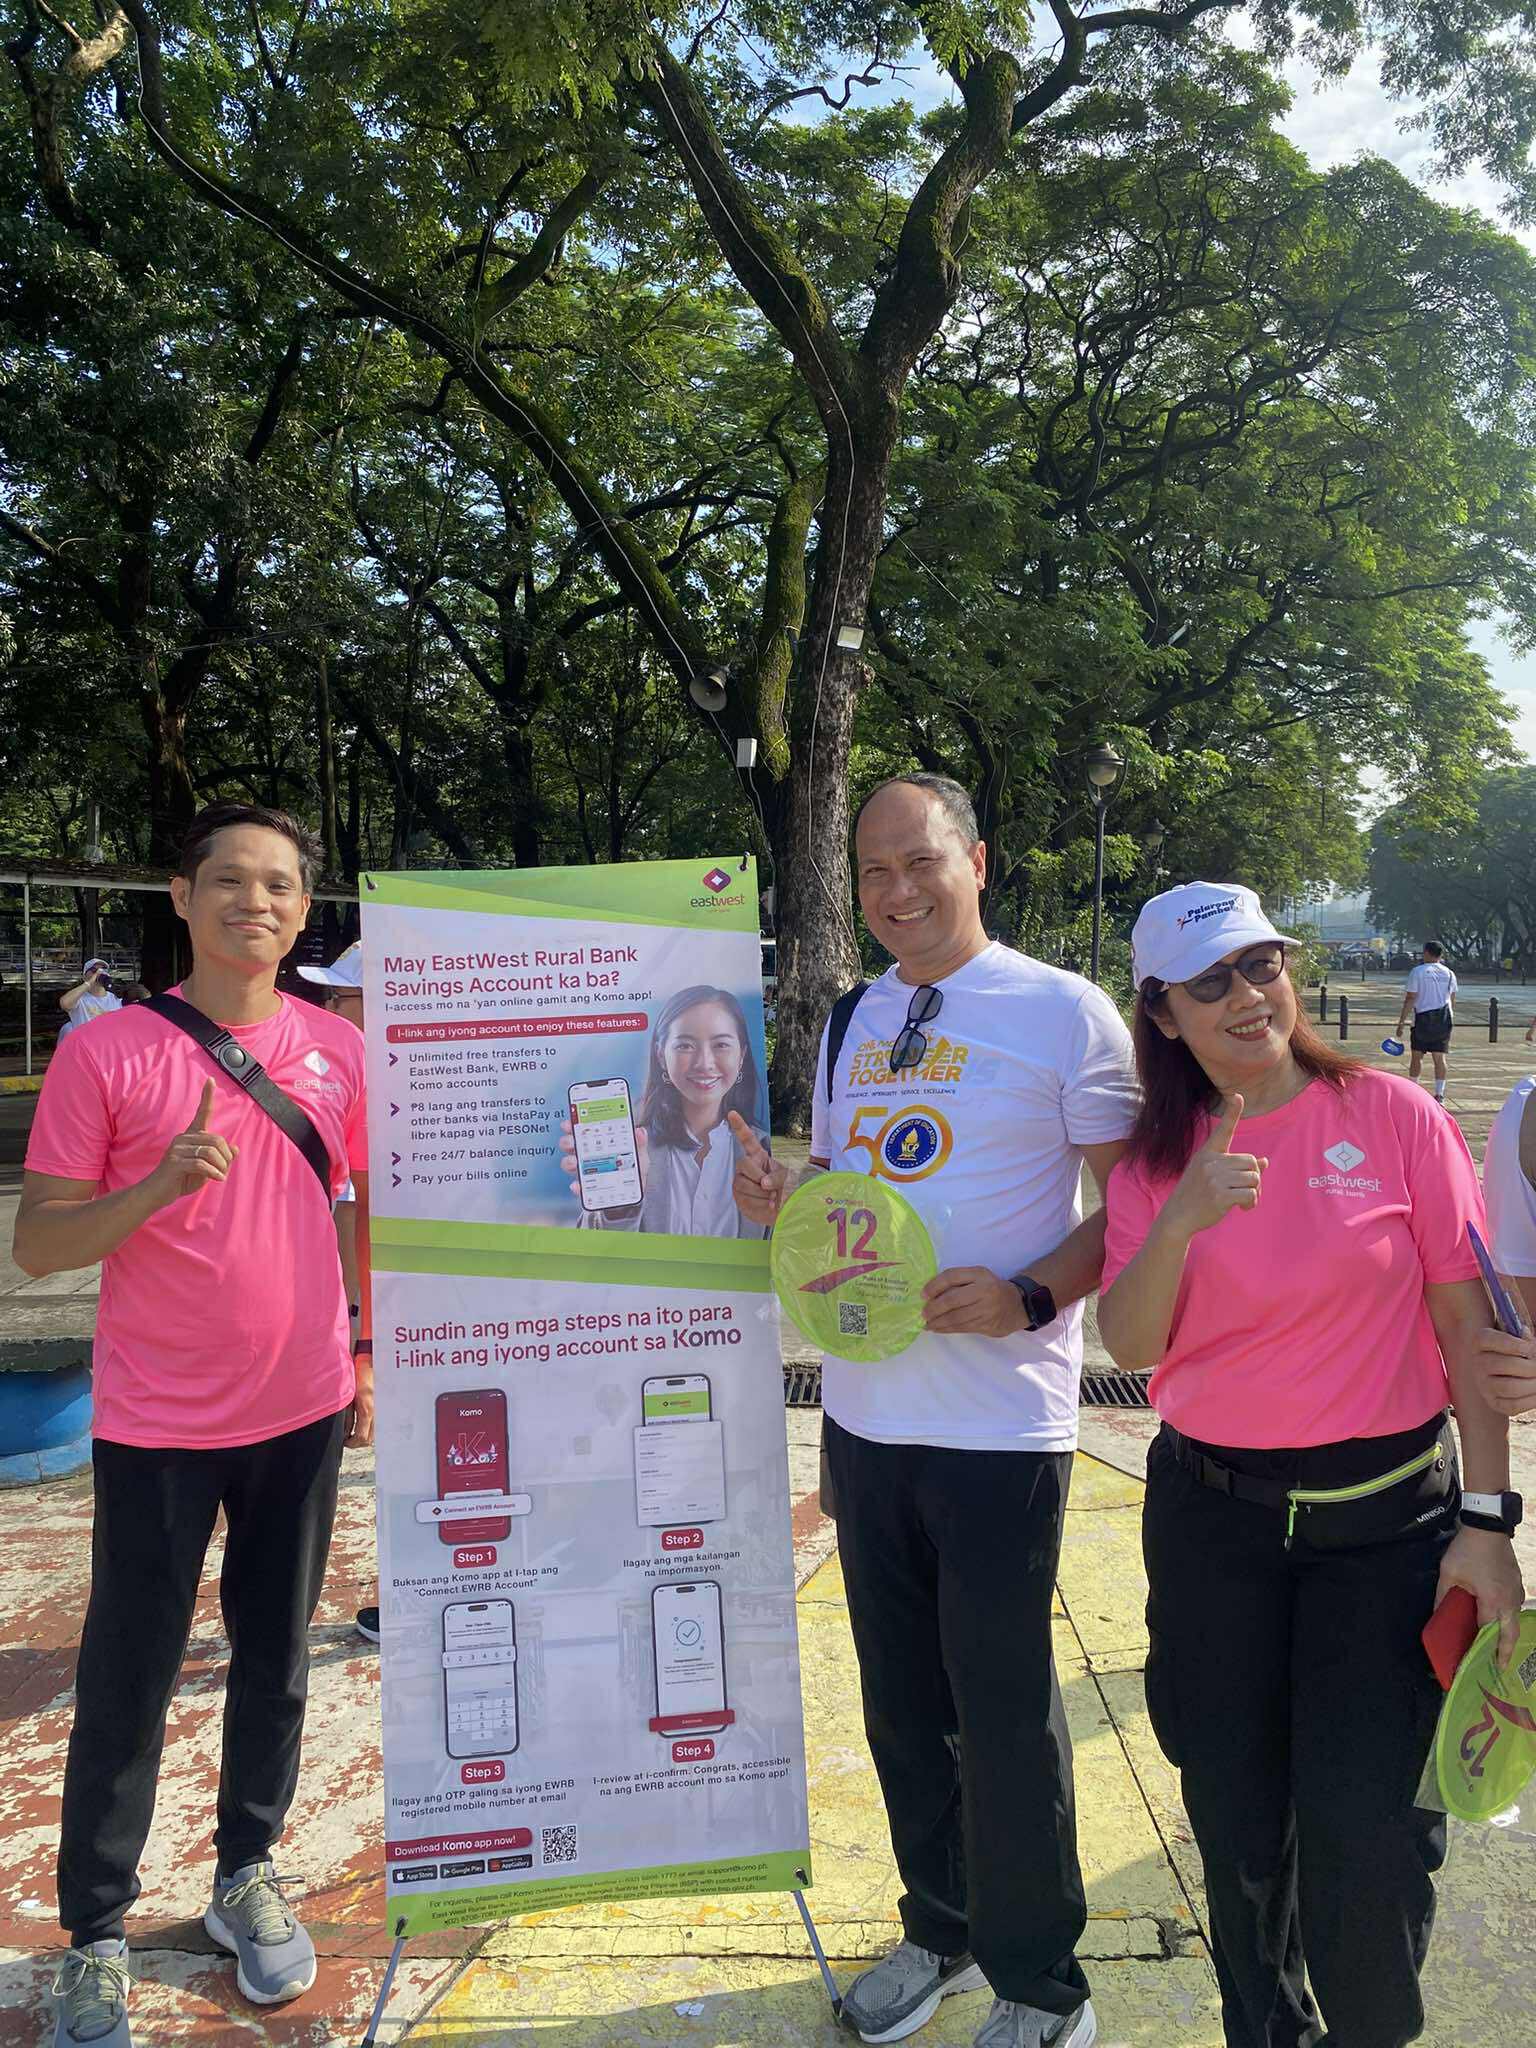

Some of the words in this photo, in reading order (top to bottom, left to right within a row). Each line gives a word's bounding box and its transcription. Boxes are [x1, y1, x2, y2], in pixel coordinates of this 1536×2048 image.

[690, 895, 746, 907] eastwest
[1187, 899, 1235, 918] Palarong
[384, 956, 425, 976] May
[432, 951, 528, 971] EastWest
[535, 948, 583, 967] Rural
[590, 946, 638, 964] Bank
[384, 978, 463, 997] Savings
[470, 974, 552, 993] Account
[559, 972, 580, 988] ka
[586, 970, 620, 987] ba?
[385, 1002, 432, 1012] I-access
[474, 999, 497, 1010] 'yan
[500, 996, 533, 1006] online
[537, 995, 567, 1007] gamit
[570, 994, 590, 1004] ang
[594, 992, 624, 1002] Komo
[628, 991, 652, 1002] app!
[397, 1028, 424, 1038] I-link
[426, 1028, 446, 1039] ang
[448, 1025, 477, 1038] iyong
[479, 1023, 520, 1034] account
[524, 1022, 534, 1032] to
[536, 1021, 564, 1034] enjoy
[566, 1019, 594, 1030] these
[597, 1017, 641, 1028] features:
[409, 1051, 463, 1062] Unlimited
[466, 1049, 488, 1060] free
[492, 1048, 542, 1058] transfers
[545, 1047, 556, 1056] to
[410, 1066, 462, 1076] EastWest
[466, 1064, 498, 1076] Bank,
[502, 1061, 537, 1072] EWRB
[848, 1066, 962, 1087] TOGETHER
[410, 1080, 442, 1090] Komo
[446, 1078, 498, 1088] accounts
[428, 1100, 453, 1113] lang
[456, 1100, 478, 1112] ang
[480, 1097, 532, 1108] transfers
[534, 1096, 546, 1106] to
[411, 1116, 440, 1126] other
[444, 1113, 478, 1124] banks
[482, 1112, 498, 1122] via
[502, 1109, 551, 1123] InstaPay
[554, 1110, 565, 1119] at
[411, 1130, 437, 1140] libre
[440, 1128, 476, 1140] kapag
[478, 1126, 495, 1137] via
[498, 1124, 550, 1136] PESONet
[843, 1104, 953, 1183] 50
[412, 1151, 437, 1162] Free
[440, 1150, 466, 1161] 24/7
[469, 1147, 514, 1158] balance
[517, 1145, 556, 1158] inquiry
[412, 1174, 434, 1186] Pay
[437, 1174, 463, 1184] your
[466, 1170, 490, 1181] bills
[493, 1168, 528, 1180] online
[1308, 1172, 1382, 1192] eastwest
[826, 1207, 878, 1260] 12
[394, 1322, 466, 1344] Sundin
[472, 1321, 509, 1340] ang
[515, 1318, 560, 1338] mga
[564, 1312, 622, 1334] steps
[626, 1310, 652, 1326] na
[656, 1308, 682, 1325] ito
[688, 1306, 733, 1326] para
[394, 1348, 446, 1369] i-link
[450, 1346, 488, 1367] ang
[494, 1340, 550, 1364] iyong
[556, 1334, 638, 1358] account
[644, 1334, 666, 1350] sa
[672, 1326, 742, 1350] Komo
[459, 1408, 483, 1417] Komo
[1416, 1506, 1446, 1524] MINISO
[666, 1534, 691, 1546] Step
[693, 1533, 700, 1543] 2
[457, 1551, 484, 1564] Step
[486, 1550, 493, 1560] 1
[624, 1558, 652, 1568] Ilagay
[654, 1556, 672, 1566] ang
[674, 1555, 694, 1564] mga
[696, 1550, 741, 1562] kailangan
[392, 1578, 429, 1588] Buksan
[431, 1576, 450, 1586] ang
[452, 1572, 480, 1583] Komo
[482, 1572, 501, 1582] app
[503, 1569, 514, 1578] at
[516, 1568, 538, 1578] I-tap
[540, 1566, 559, 1576] ang
[644, 1568, 656, 1577] na
[658, 1562, 724, 1576] impormasyon.
[462, 1582, 492, 1593] EWRB
[676, 1746, 702, 1758] Step
[704, 1744, 712, 1754] 4
[465, 1767, 492, 1780] Step
[494, 1766, 501, 1776] 3
[594, 1774, 631, 1786] I-review
[634, 1772, 644, 1780] at
[646, 1768, 692, 1780] i-confirm.
[694, 1764, 740, 1776] Congrats,
[742, 1758, 791, 1770] accessible
[600, 1788, 612, 1796] na
[614, 1786, 632, 1796] ang
[634, 1782, 664, 1794] EWRB
[667, 1778, 704, 1789] account
[708, 1776, 723, 1784] mo
[738, 1772, 766, 1782] Komo
[768, 1768, 790, 1779] app!
[392, 1796, 420, 1807] Ilagay
[424, 1794, 442, 1804] ang
[445, 1791, 466, 1801] OTP
[468, 1787, 498, 1800] galing
[501, 1786, 512, 1794] sa
[516, 1783, 542, 1794] iyong
[544, 1778, 574, 1790] EWRB
[400, 1806, 450, 1819] registered
[454, 1800, 486, 1812] mobile
[489, 1796, 526, 1808] number
[528, 1794, 538, 1803] at
[540, 1792, 566, 1802] email
[394, 1842, 440, 1856] Download
[442, 1840, 472, 1851] Komo
[474, 1838, 492, 1849] app
[494, 1835, 516, 1846] now!
